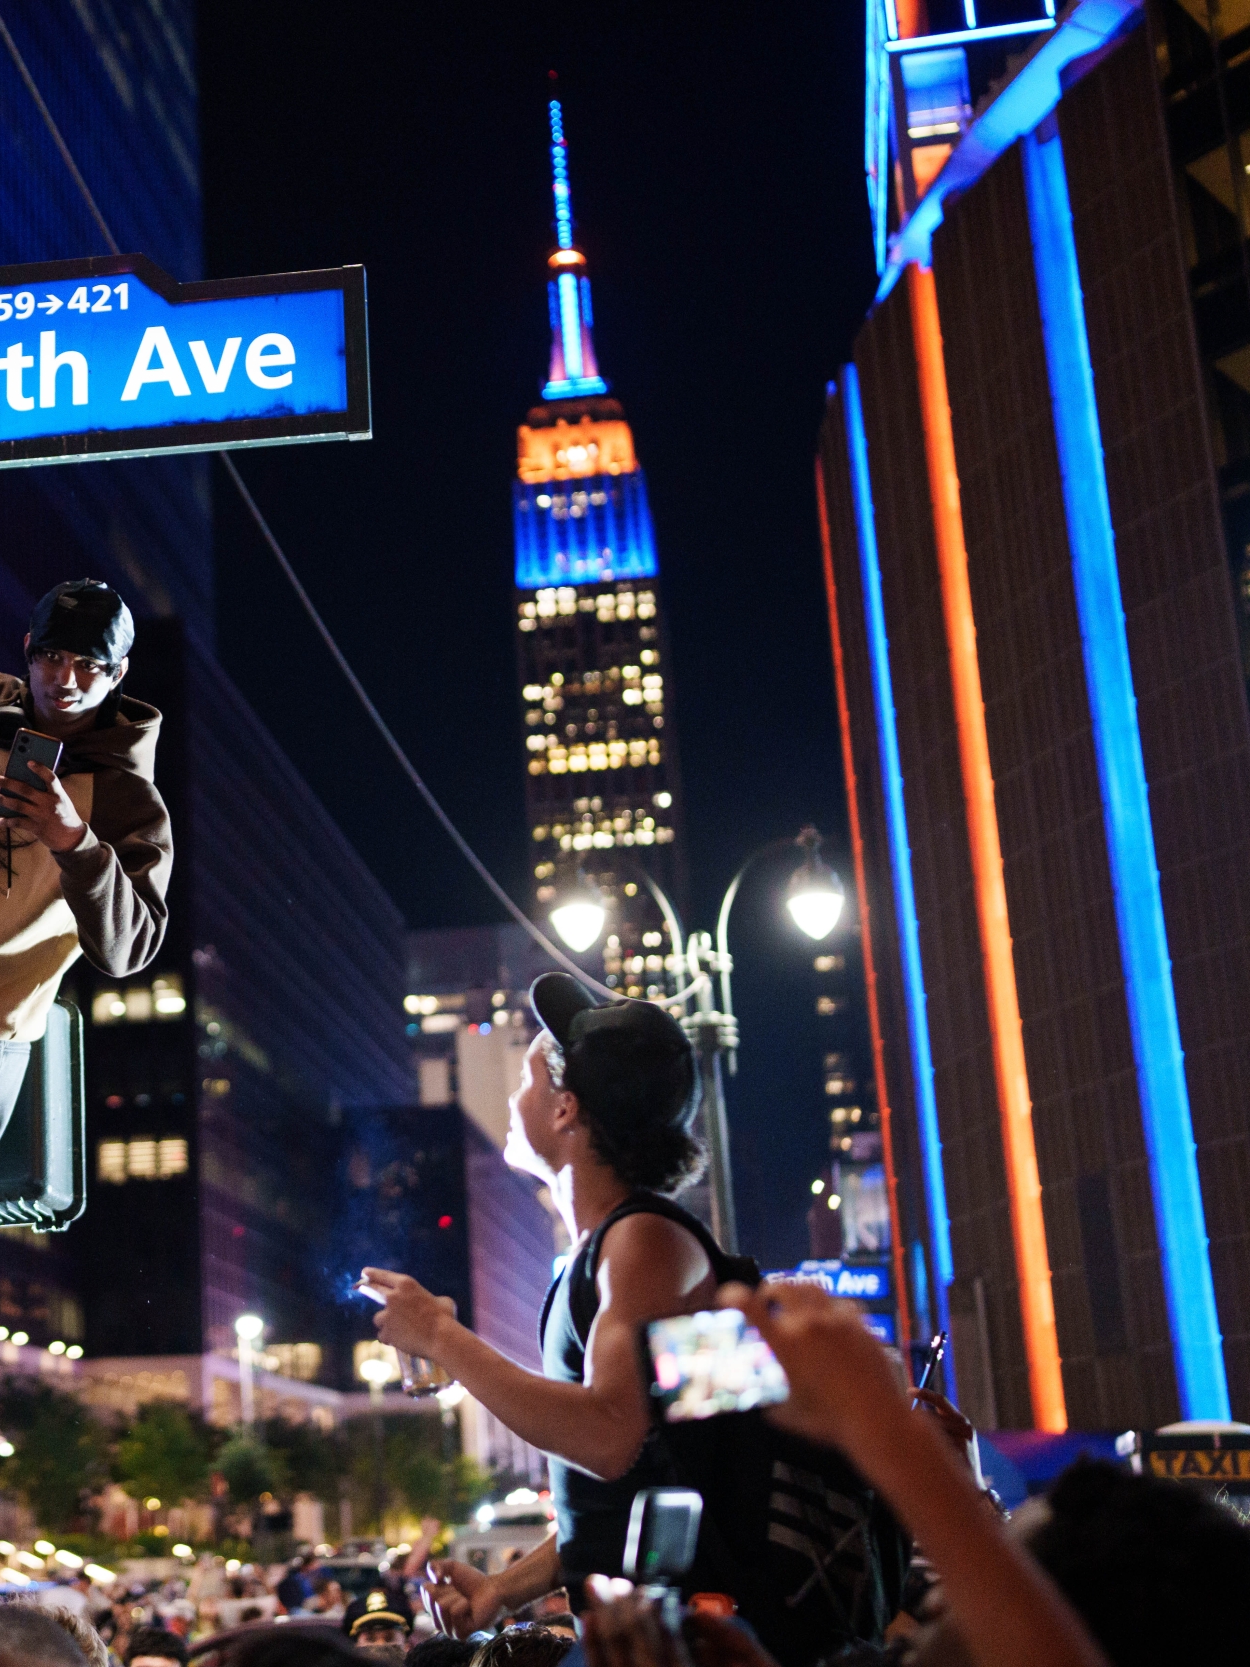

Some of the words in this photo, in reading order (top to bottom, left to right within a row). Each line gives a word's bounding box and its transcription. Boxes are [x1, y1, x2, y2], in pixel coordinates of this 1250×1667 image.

[67, 282, 130, 314] 421
[120, 325, 297, 402] Ave
[836, 1270, 880, 1295] Ave
[1156, 1449, 1240, 1476] TAXI
